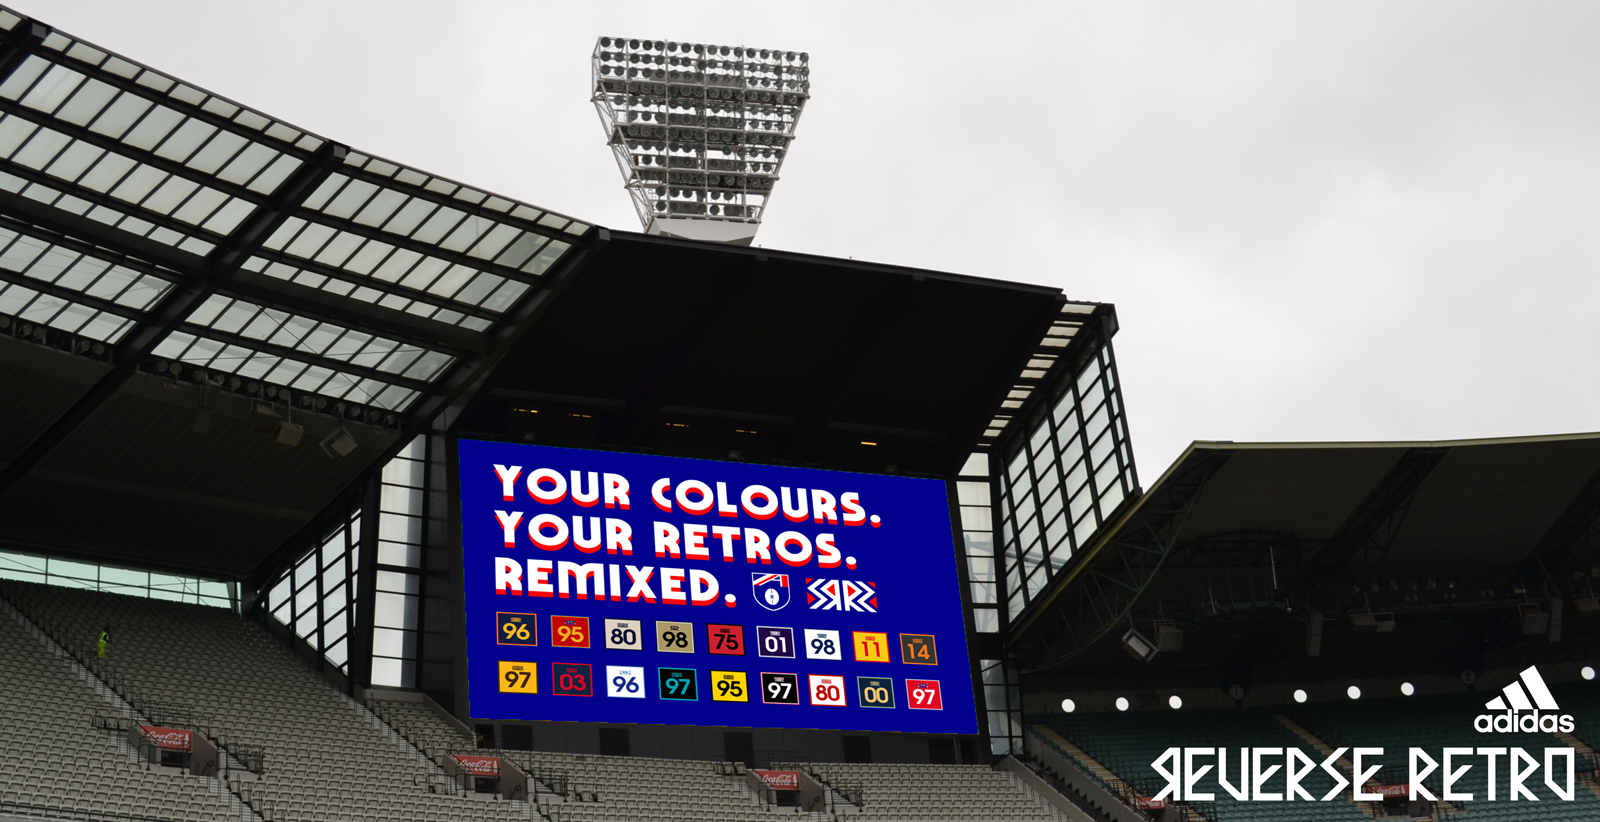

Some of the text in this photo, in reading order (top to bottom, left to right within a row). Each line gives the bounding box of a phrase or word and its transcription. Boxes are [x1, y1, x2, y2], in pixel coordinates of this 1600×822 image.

[493, 464, 882, 528] YOUR COLOURS.
[494, 509, 857, 570] YOUR RETROS.
[494, 556, 737, 608] REMIXED.
[502, 622, 531, 641] 96
[557, 625, 585, 643] 95
[610, 628, 637, 646] 80
[662, 631, 689, 648] 98
[713, 633, 739, 651] 75
[764, 636, 787, 653] 01
[810, 638, 836, 655] 98
[861, 641, 881, 658] 11
[907, 643, 931, 660] 14
[504, 670, 532, 688] 97
[559, 673, 587, 691] 03
[612, 675, 640, 694] 96
[665, 677, 691, 695] 97
[716, 679, 743, 697] 95
[767, 682, 792, 700] 97
[815, 684, 840, 702] 80
[863, 686, 889, 704] 00
[912, 688, 936, 705] 97
